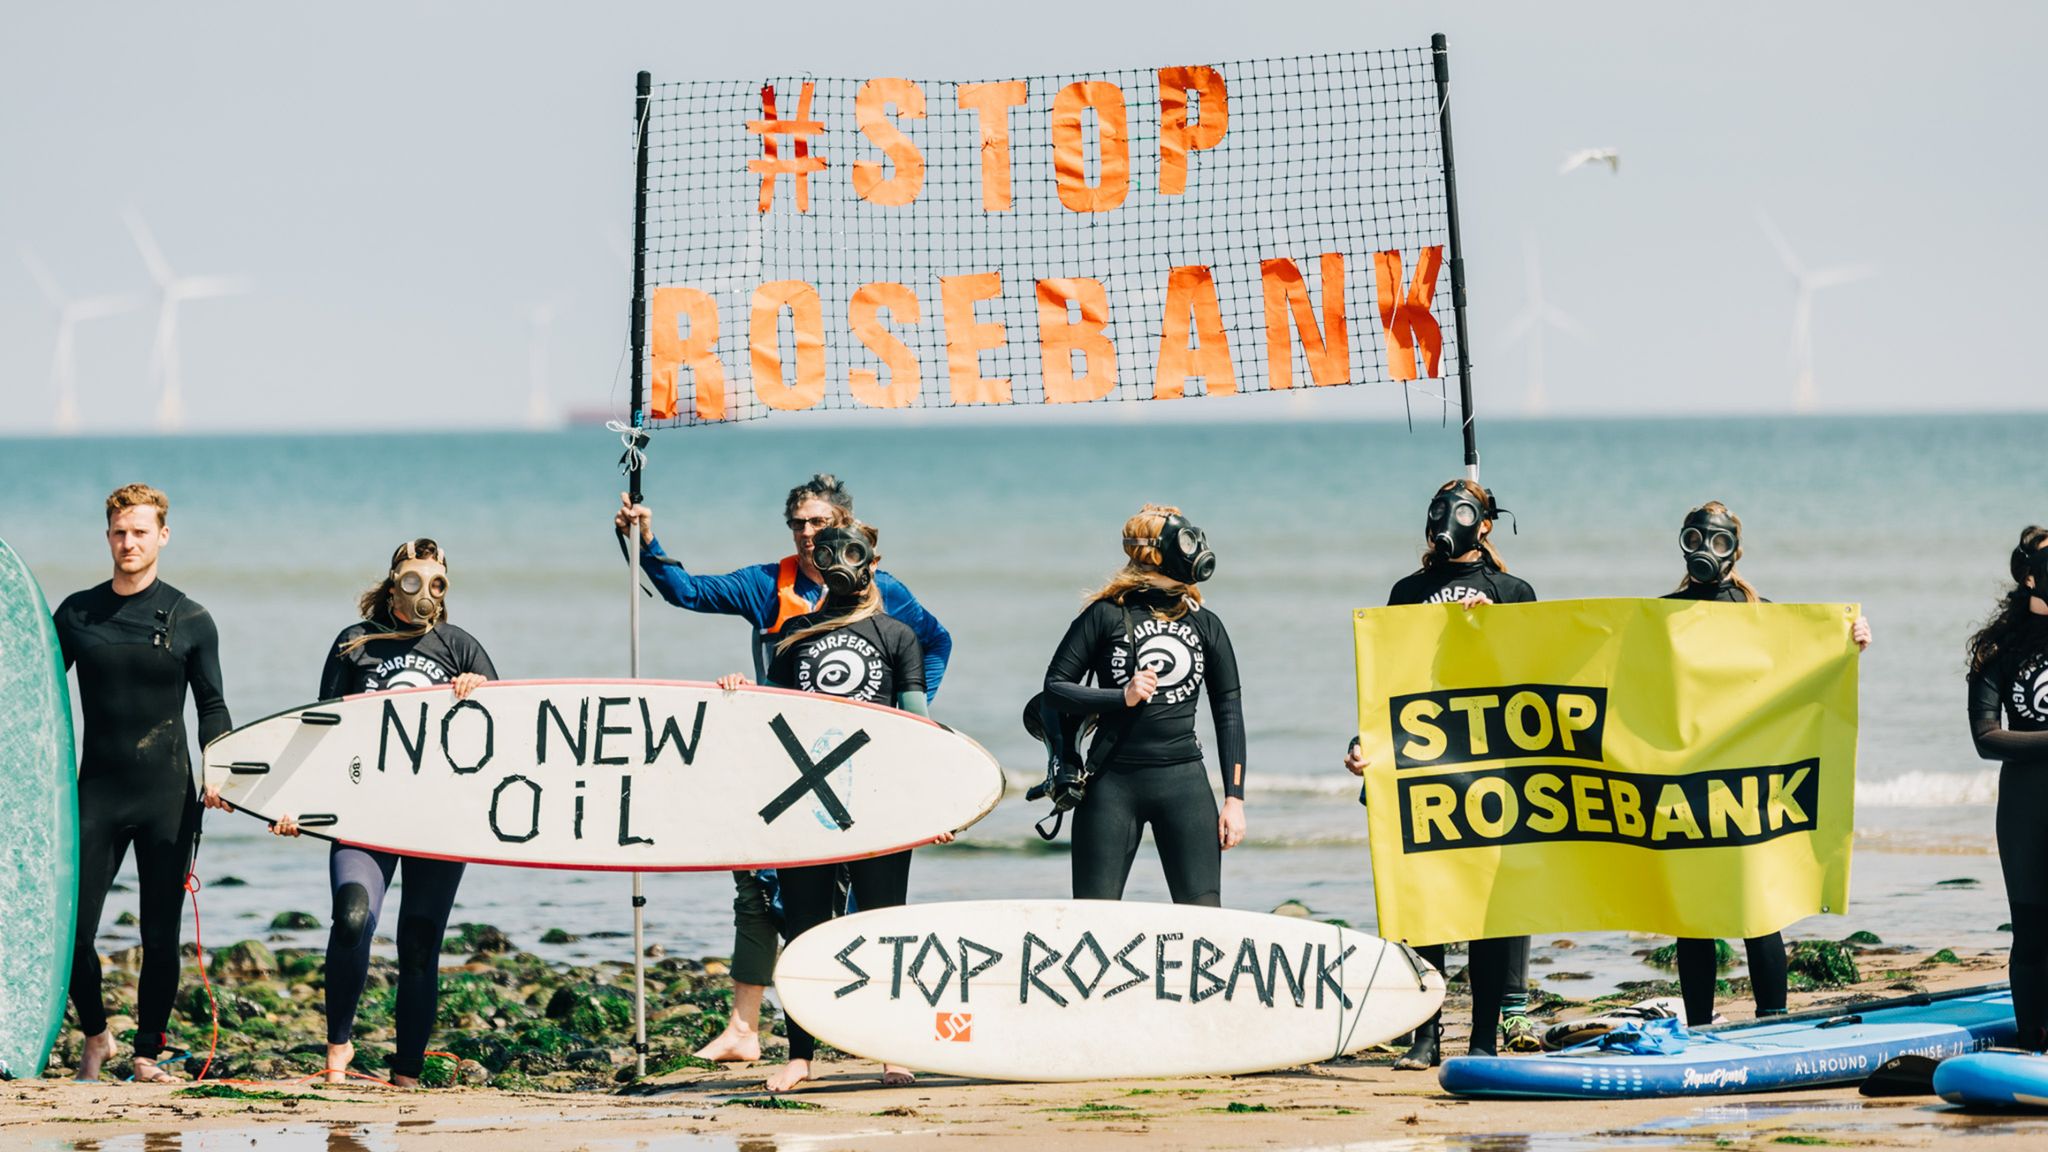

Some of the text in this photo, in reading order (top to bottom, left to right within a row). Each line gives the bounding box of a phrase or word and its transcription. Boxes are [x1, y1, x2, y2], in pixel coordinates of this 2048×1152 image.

[746, 65, 1229, 213] #STOP
[651, 245, 1443, 420] ROSEBANK
[376, 654, 445, 681] SURFERS
[808, 634, 876, 659] SURFERS
[1165, 652, 1204, 704] SEWAGE
[378, 698, 494, 775] NO
[536, 696, 707, 766] NEW
[1398, 690, 1598, 761] STOP
[1408, 766, 1811, 845] ROSEBANK
[833, 930, 1357, 1010] STOP ROSEBANK
[1794, 1054, 1868, 1075] ALLROUND
